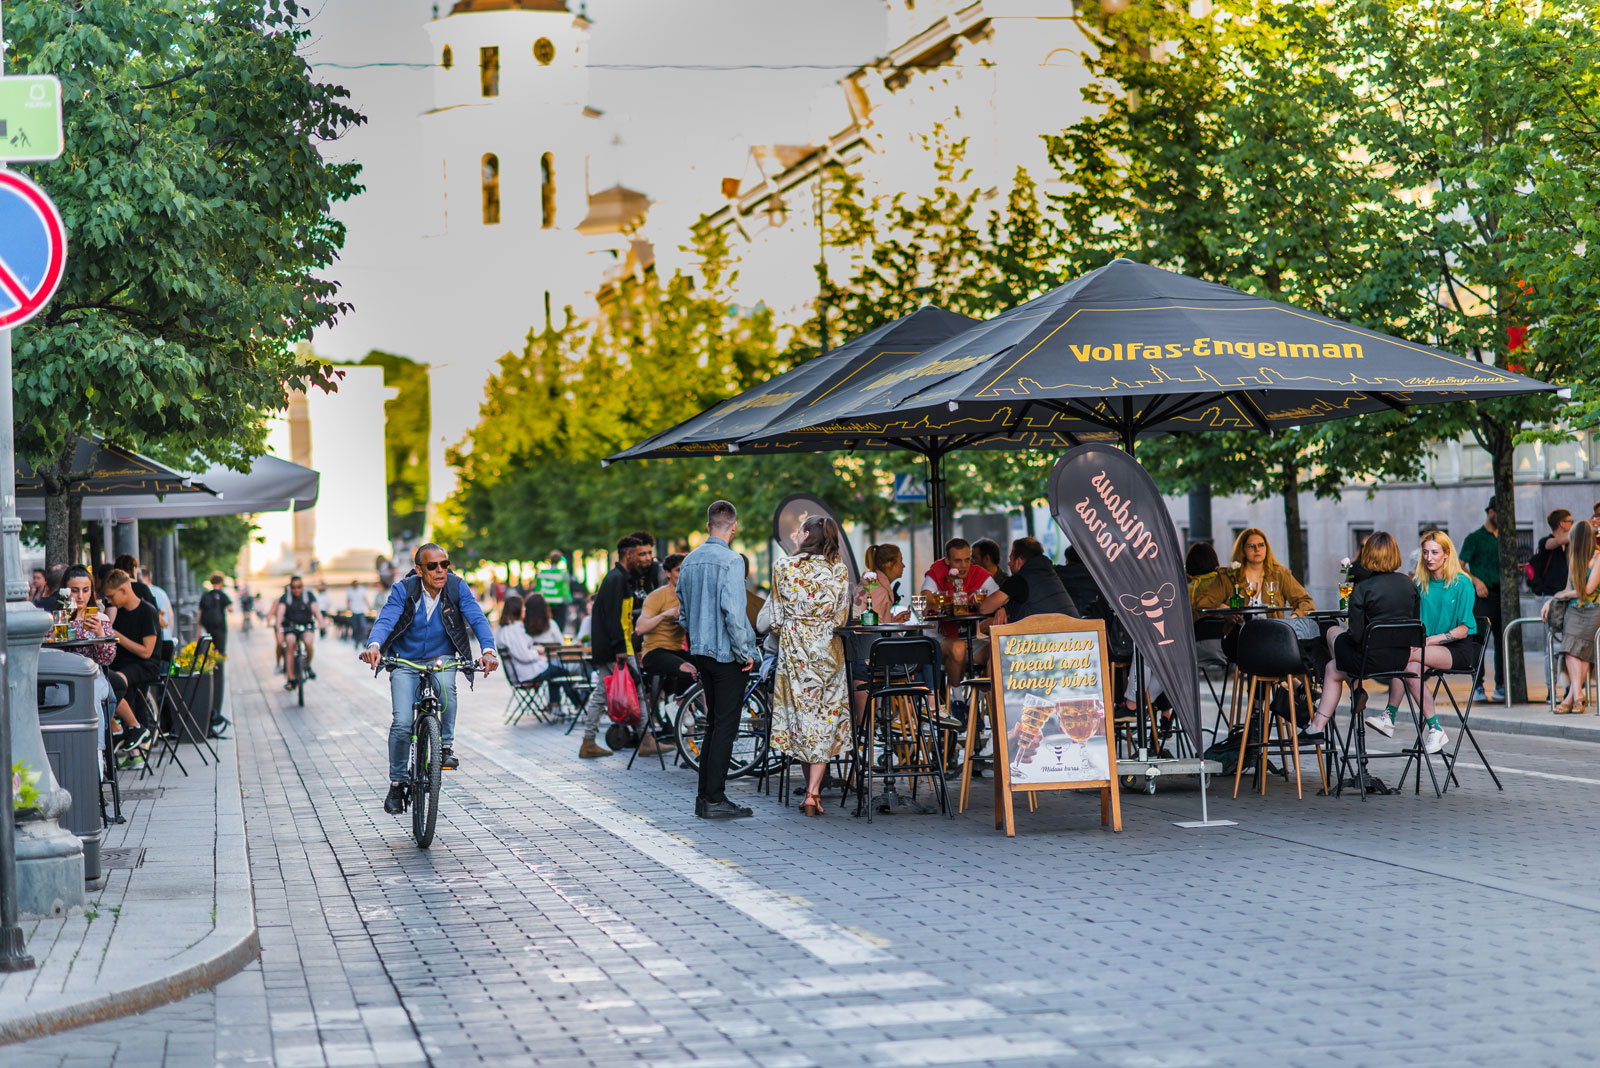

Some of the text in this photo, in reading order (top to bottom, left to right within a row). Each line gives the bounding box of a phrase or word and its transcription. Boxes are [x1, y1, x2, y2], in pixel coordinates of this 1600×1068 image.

[1004, 637, 1095, 655] Lithuanian
[1010, 653, 1092, 673] mead and
[1006, 672, 1098, 695] honey wine
